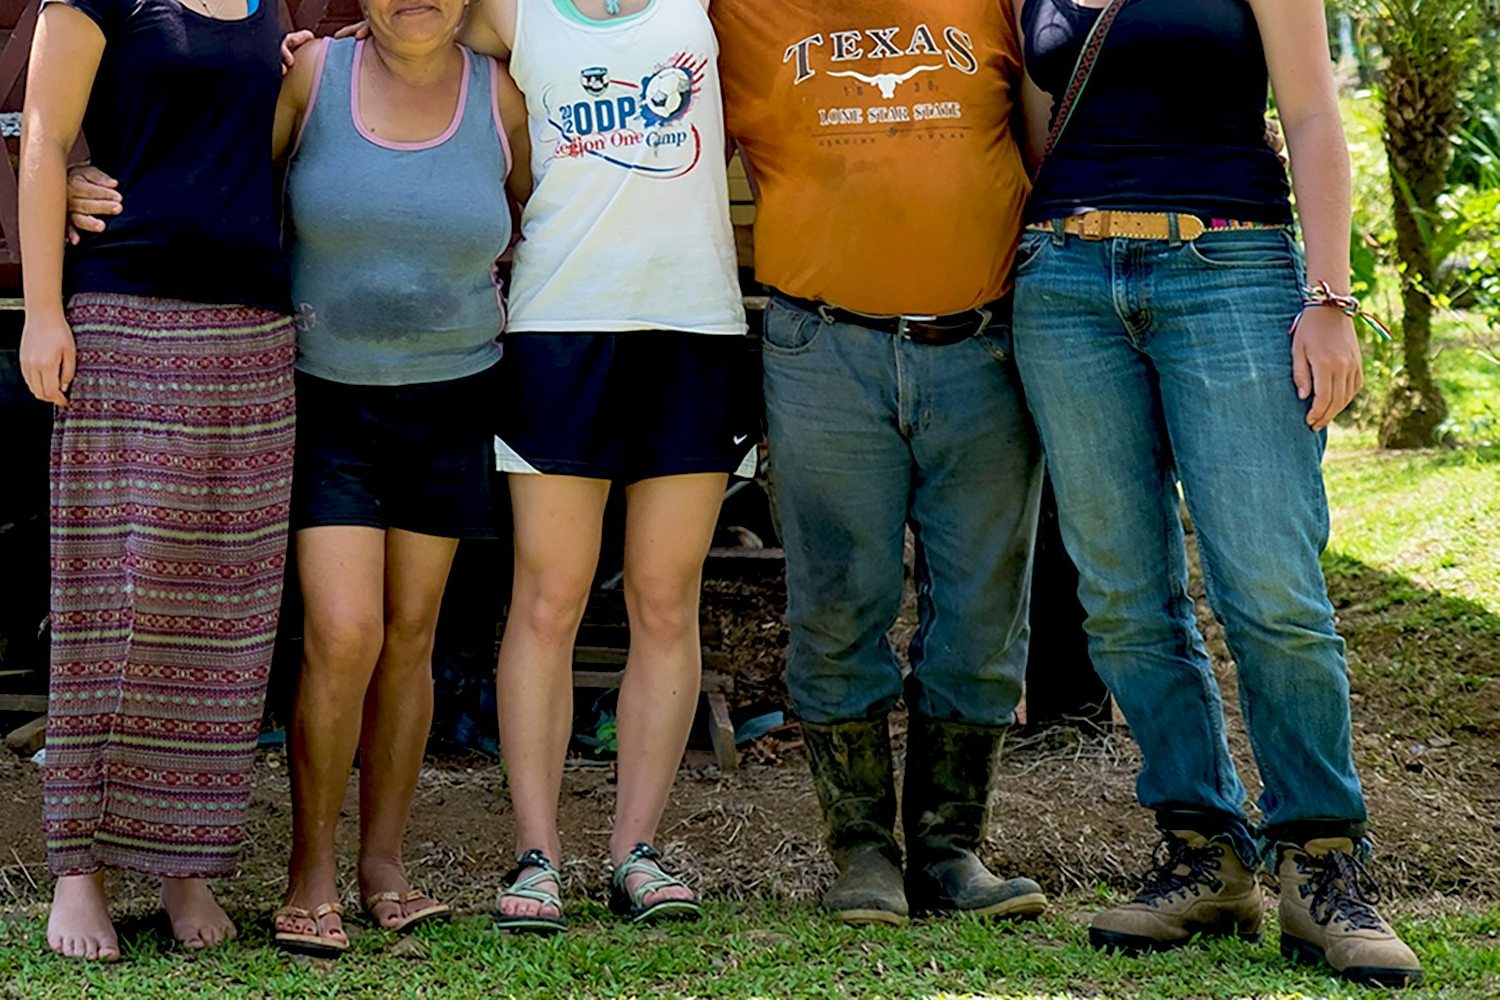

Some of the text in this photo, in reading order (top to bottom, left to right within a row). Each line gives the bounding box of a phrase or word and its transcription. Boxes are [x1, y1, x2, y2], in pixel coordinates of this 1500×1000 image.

[783, 24, 978, 85] TEXAS
[573, 96, 636, 136] ODP
[818, 102, 962, 126] LONE STAR STATE
[610, 131, 645, 147] One
